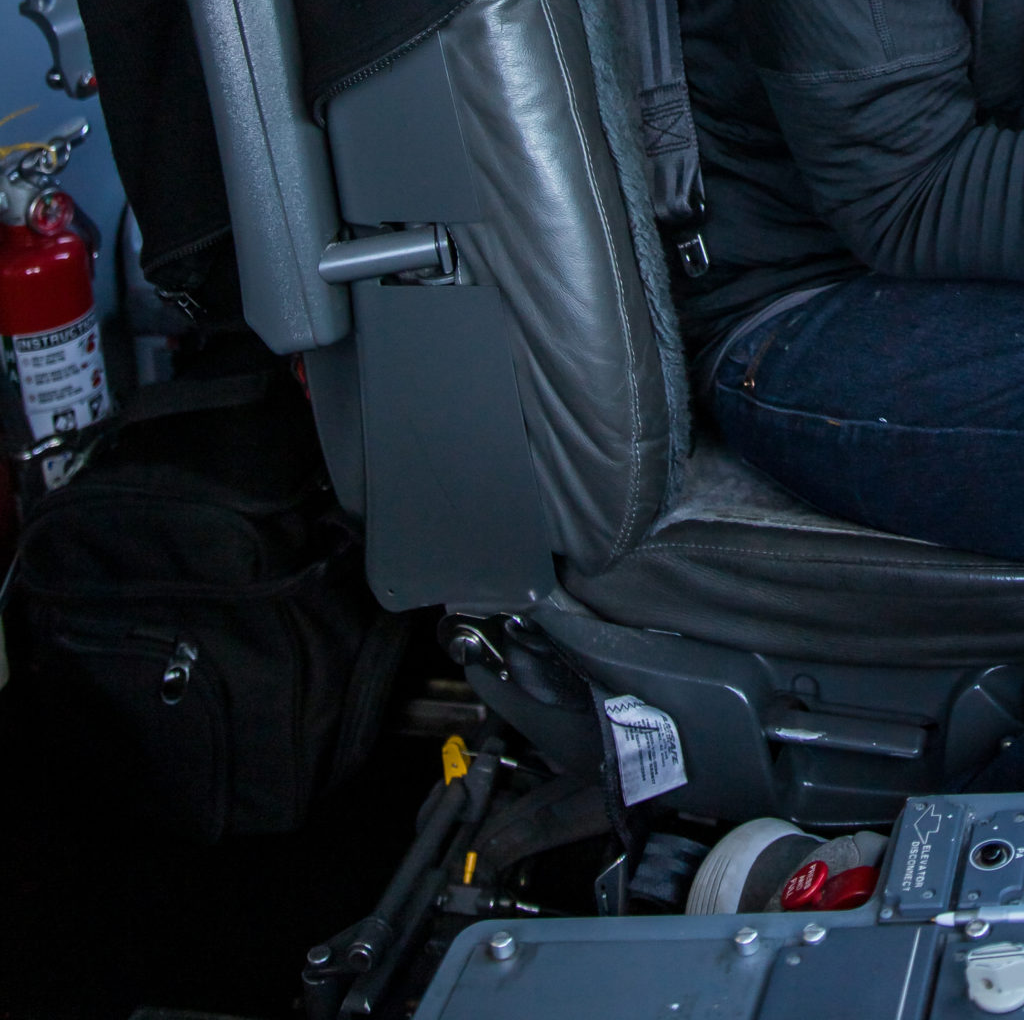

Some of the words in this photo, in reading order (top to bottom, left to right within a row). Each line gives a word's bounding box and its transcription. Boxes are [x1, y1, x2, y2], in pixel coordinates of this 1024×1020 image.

[902, 841, 920, 892] DISCONNECT
[916, 844, 932, 889] ELEVATOR
[1015, 846, 1024, 859] PA
